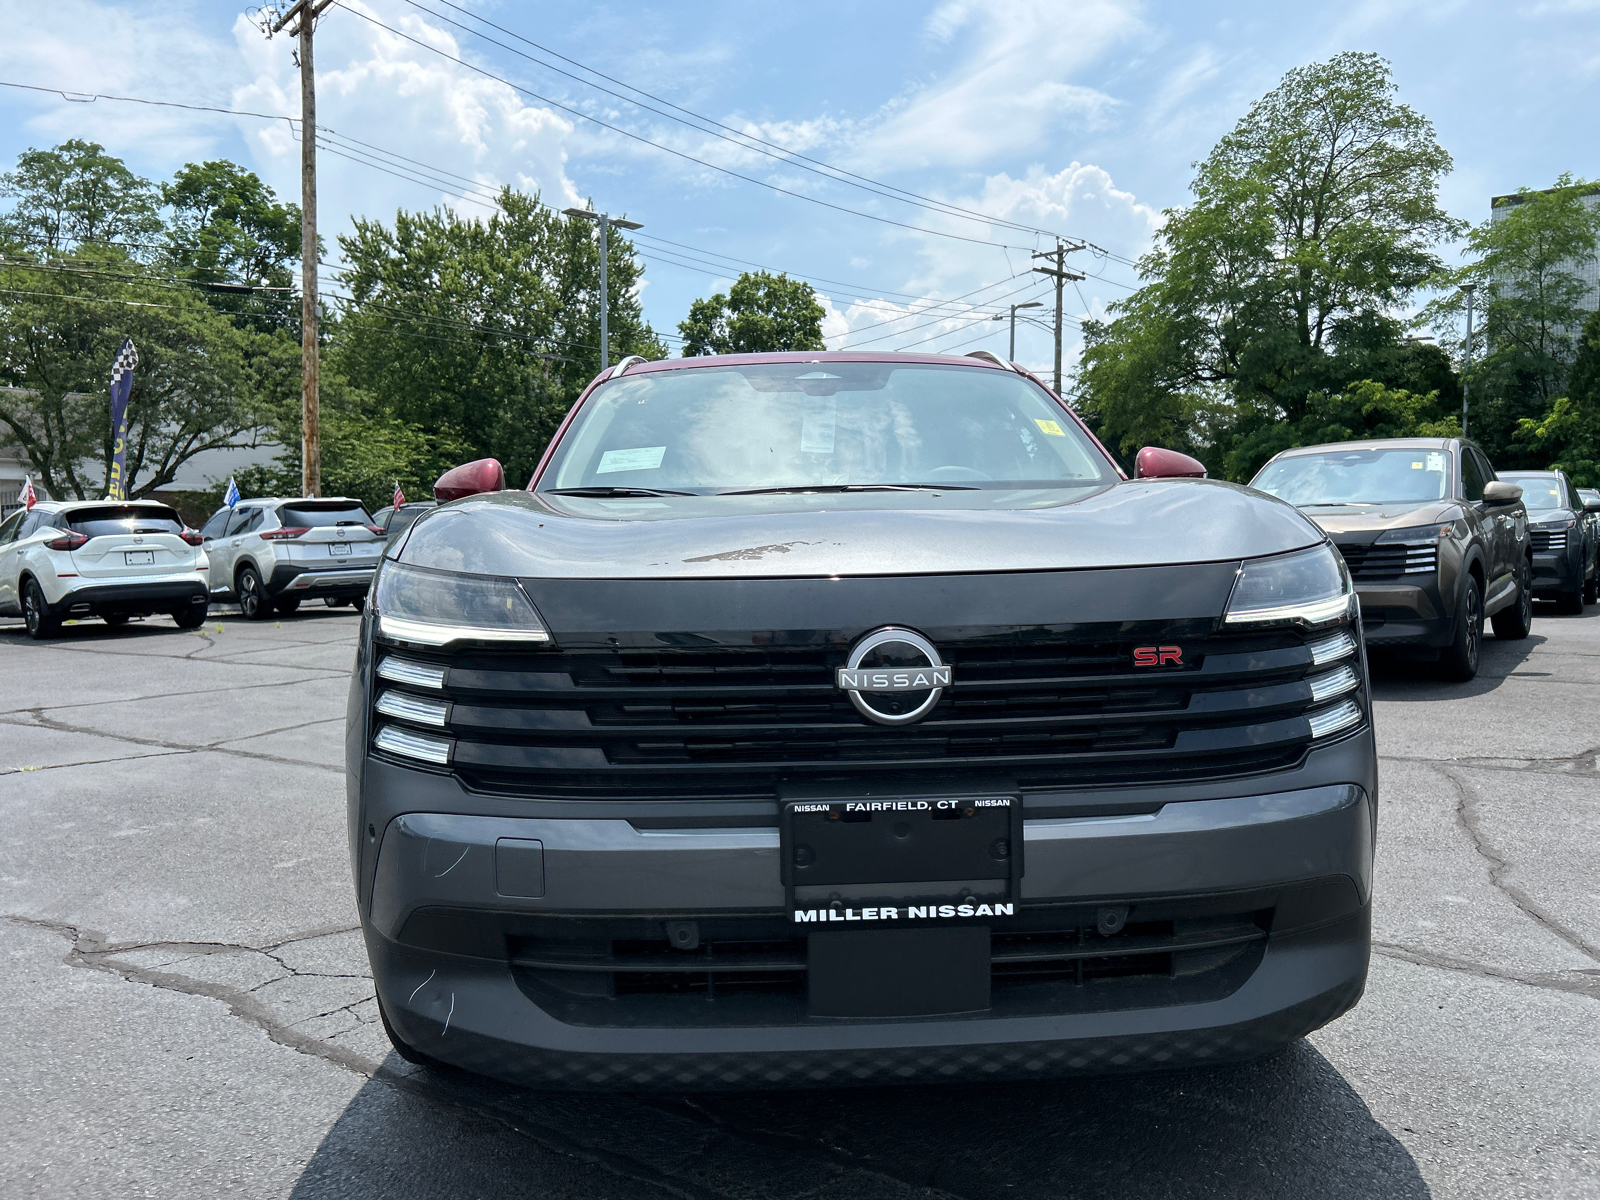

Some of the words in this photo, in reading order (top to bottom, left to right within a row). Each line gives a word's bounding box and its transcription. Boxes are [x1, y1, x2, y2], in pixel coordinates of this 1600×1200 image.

[1133, 645, 1183, 667] SR
[841, 670, 950, 688] NISSAN
[794, 804, 830, 813] NISSAN
[846, 801, 932, 812] FAIRFIELD,
[936, 800, 959, 810] CT
[974, 799, 1011, 807] NISSAN
[794, 906, 899, 923] MILLER
[908, 903, 1014, 919] NISSAN
